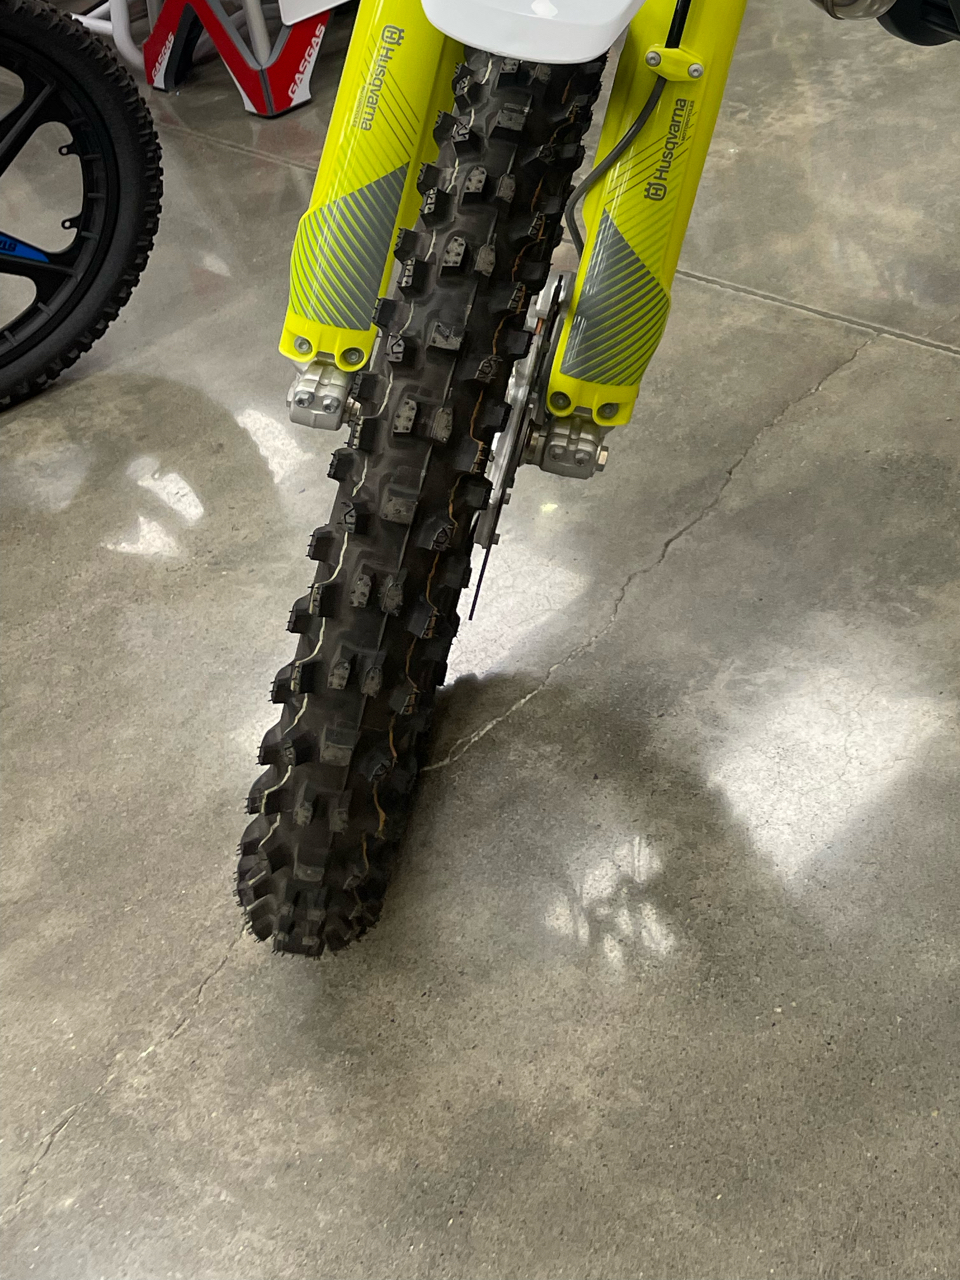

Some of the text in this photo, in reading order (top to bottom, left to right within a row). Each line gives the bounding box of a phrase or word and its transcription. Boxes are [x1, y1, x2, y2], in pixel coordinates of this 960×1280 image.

[151, 31, 175, 80] GASGAS
[288, 22, 326, 100] GASGAS
[360, 45, 395, 132] Husqvarna
[653, 97, 688, 181] Husqvarna
[681, 101, 695, 142] MOTORCYCLES
